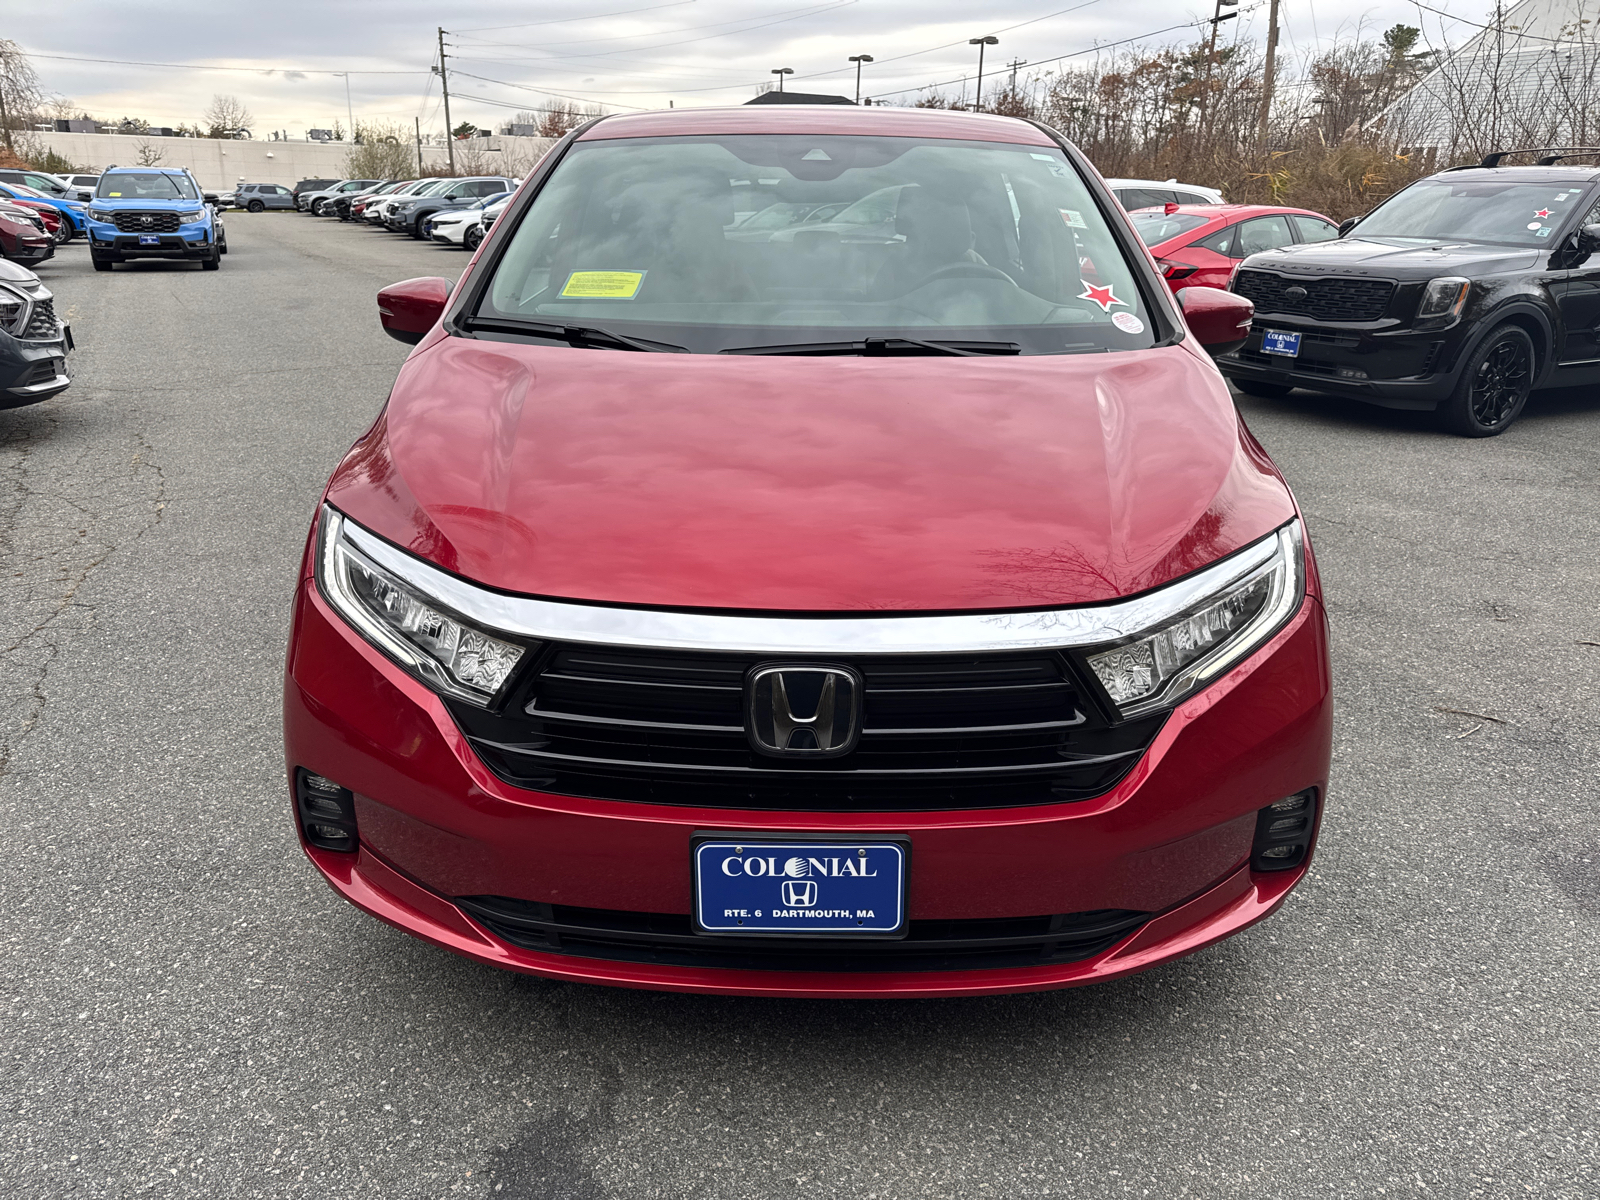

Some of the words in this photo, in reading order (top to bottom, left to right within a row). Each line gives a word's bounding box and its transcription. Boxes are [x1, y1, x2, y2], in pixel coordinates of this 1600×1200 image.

[721, 856, 878, 878] COLONIAL
[724, 909, 752, 918] RTE.
[754, 909, 763, 918] 6
[772, 909, 853, 920] DARTMOUTH,
[856, 910, 876, 919] MA
